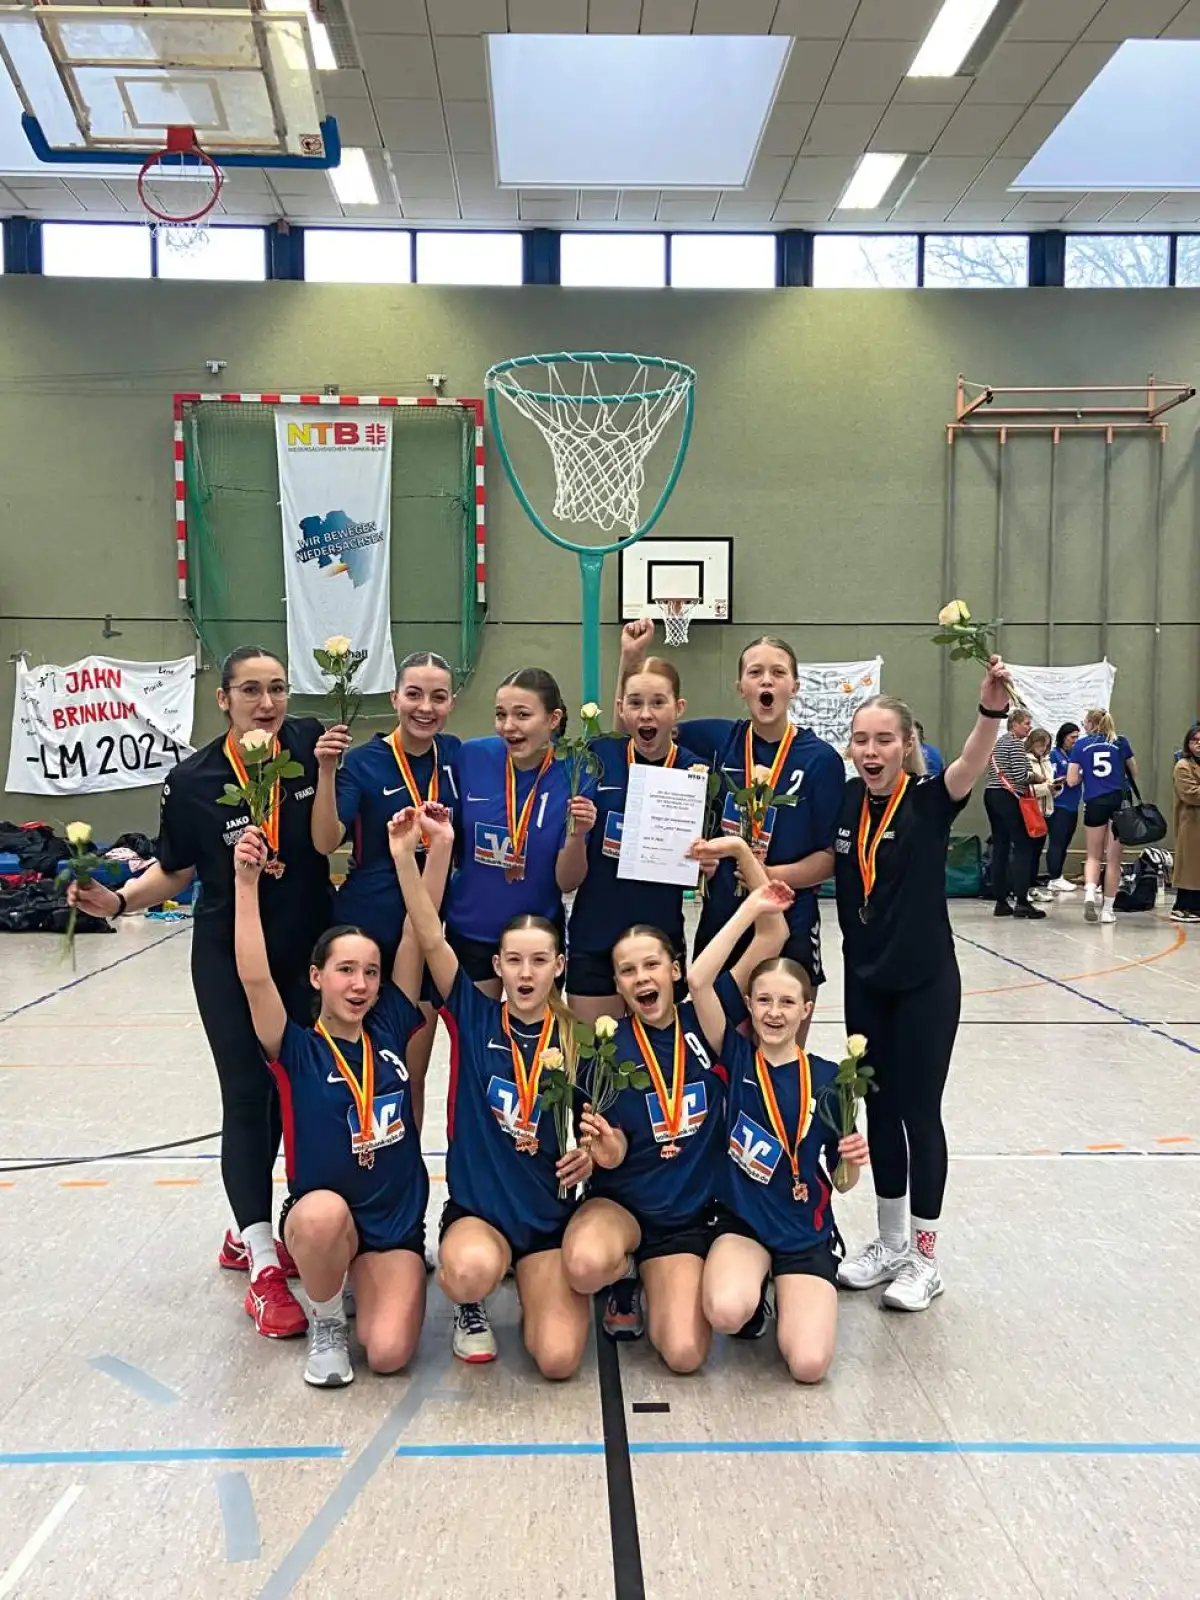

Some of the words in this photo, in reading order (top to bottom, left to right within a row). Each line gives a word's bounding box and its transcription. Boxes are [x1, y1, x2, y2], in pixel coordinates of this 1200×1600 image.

[288, 422, 360, 445] NTB
[295, 531, 384, 562] NIEDERSACHSEN
[298, 535, 321, 549] WIR
[323, 521, 377, 543] BEWEGEN
[66, 668, 122, 693] JAHN
[53, 701, 138, 730] BRINKUM
[97, 733, 187, 775] 2024
[1093, 752, 1112, 777] 5
[784, 769, 804, 807] 2
[225, 816, 249, 830] JAKO
[536, 792, 549, 828] 1
[379, 1049, 409, 1082] 3
[684, 1032, 711, 1069] 9
